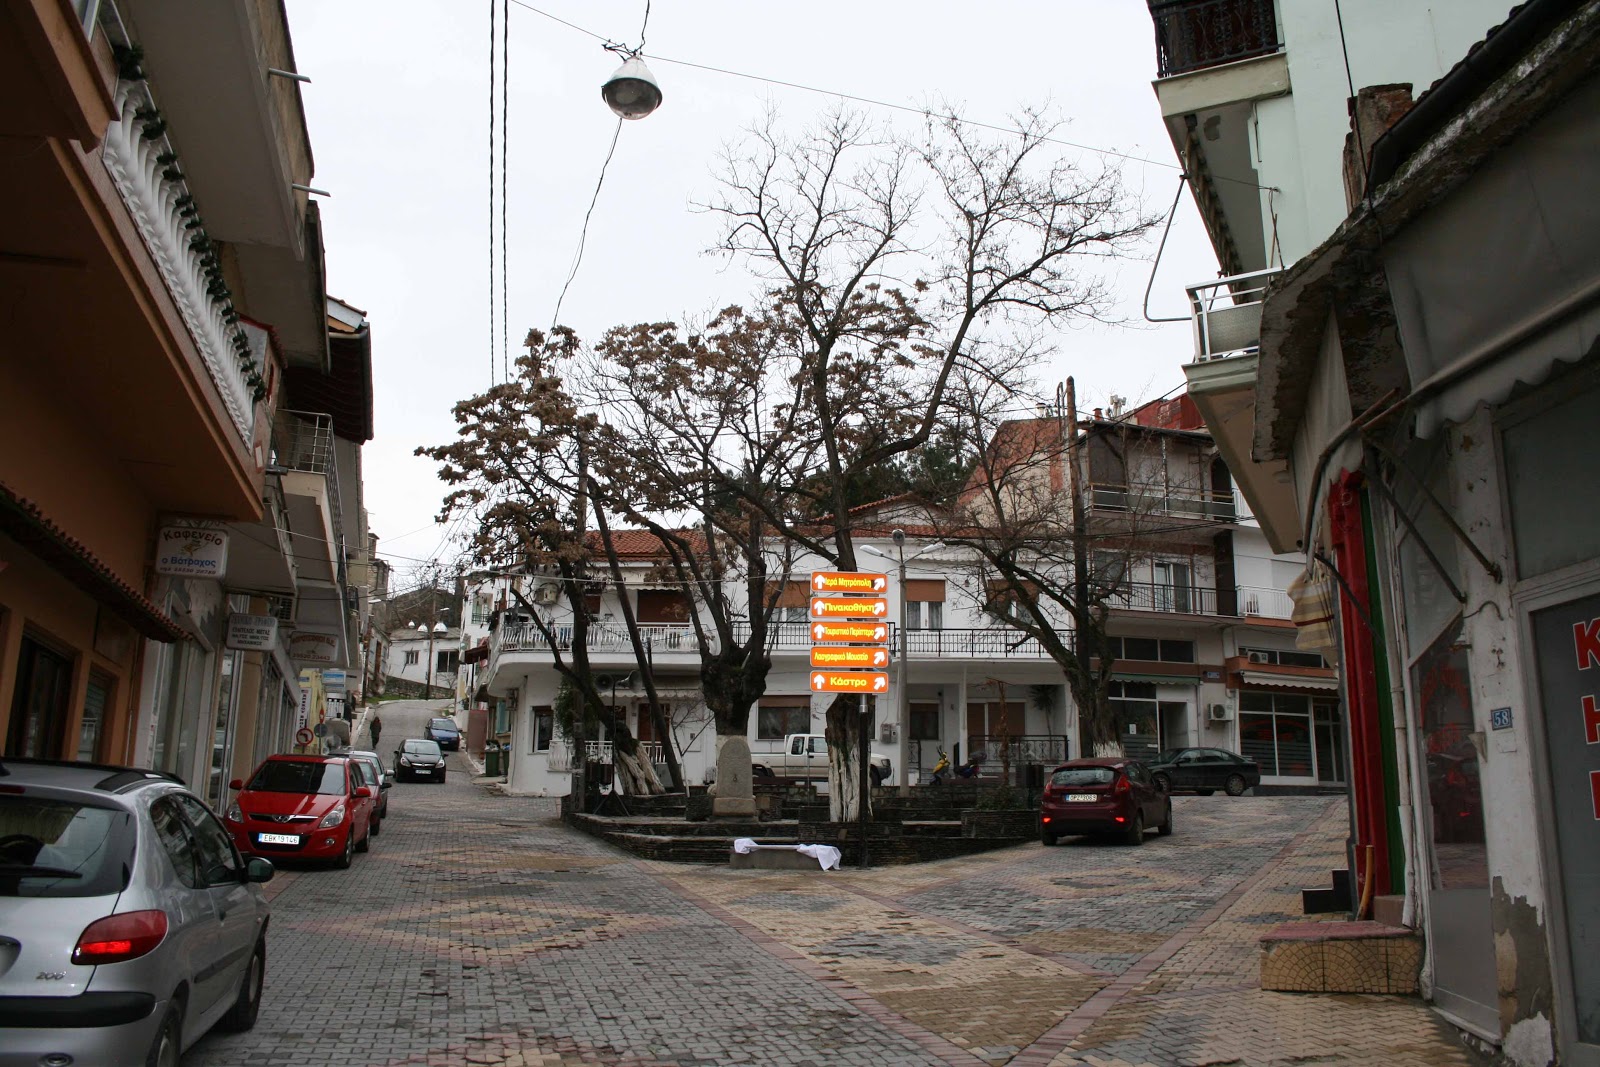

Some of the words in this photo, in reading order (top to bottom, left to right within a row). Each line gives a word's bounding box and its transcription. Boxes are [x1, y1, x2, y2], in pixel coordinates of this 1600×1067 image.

[163, 530, 222, 546] Καφενείο
[171, 556, 217, 568] Βάτραχος
[825, 577, 838, 587] Ιερά
[838, 577, 872, 588] Μητρόπολη
[824, 603, 874, 613] Πινακοθήκη
[824, 626, 849, 636] Τουριστικό
[849, 627, 875, 637] Περίπτερο
[814, 652, 846, 662] Λαογραφικό
[846, 652, 869, 661] Μουσείο
[830, 677, 867, 687] Κάστρο
[1494, 711, 1509, 727] 58
